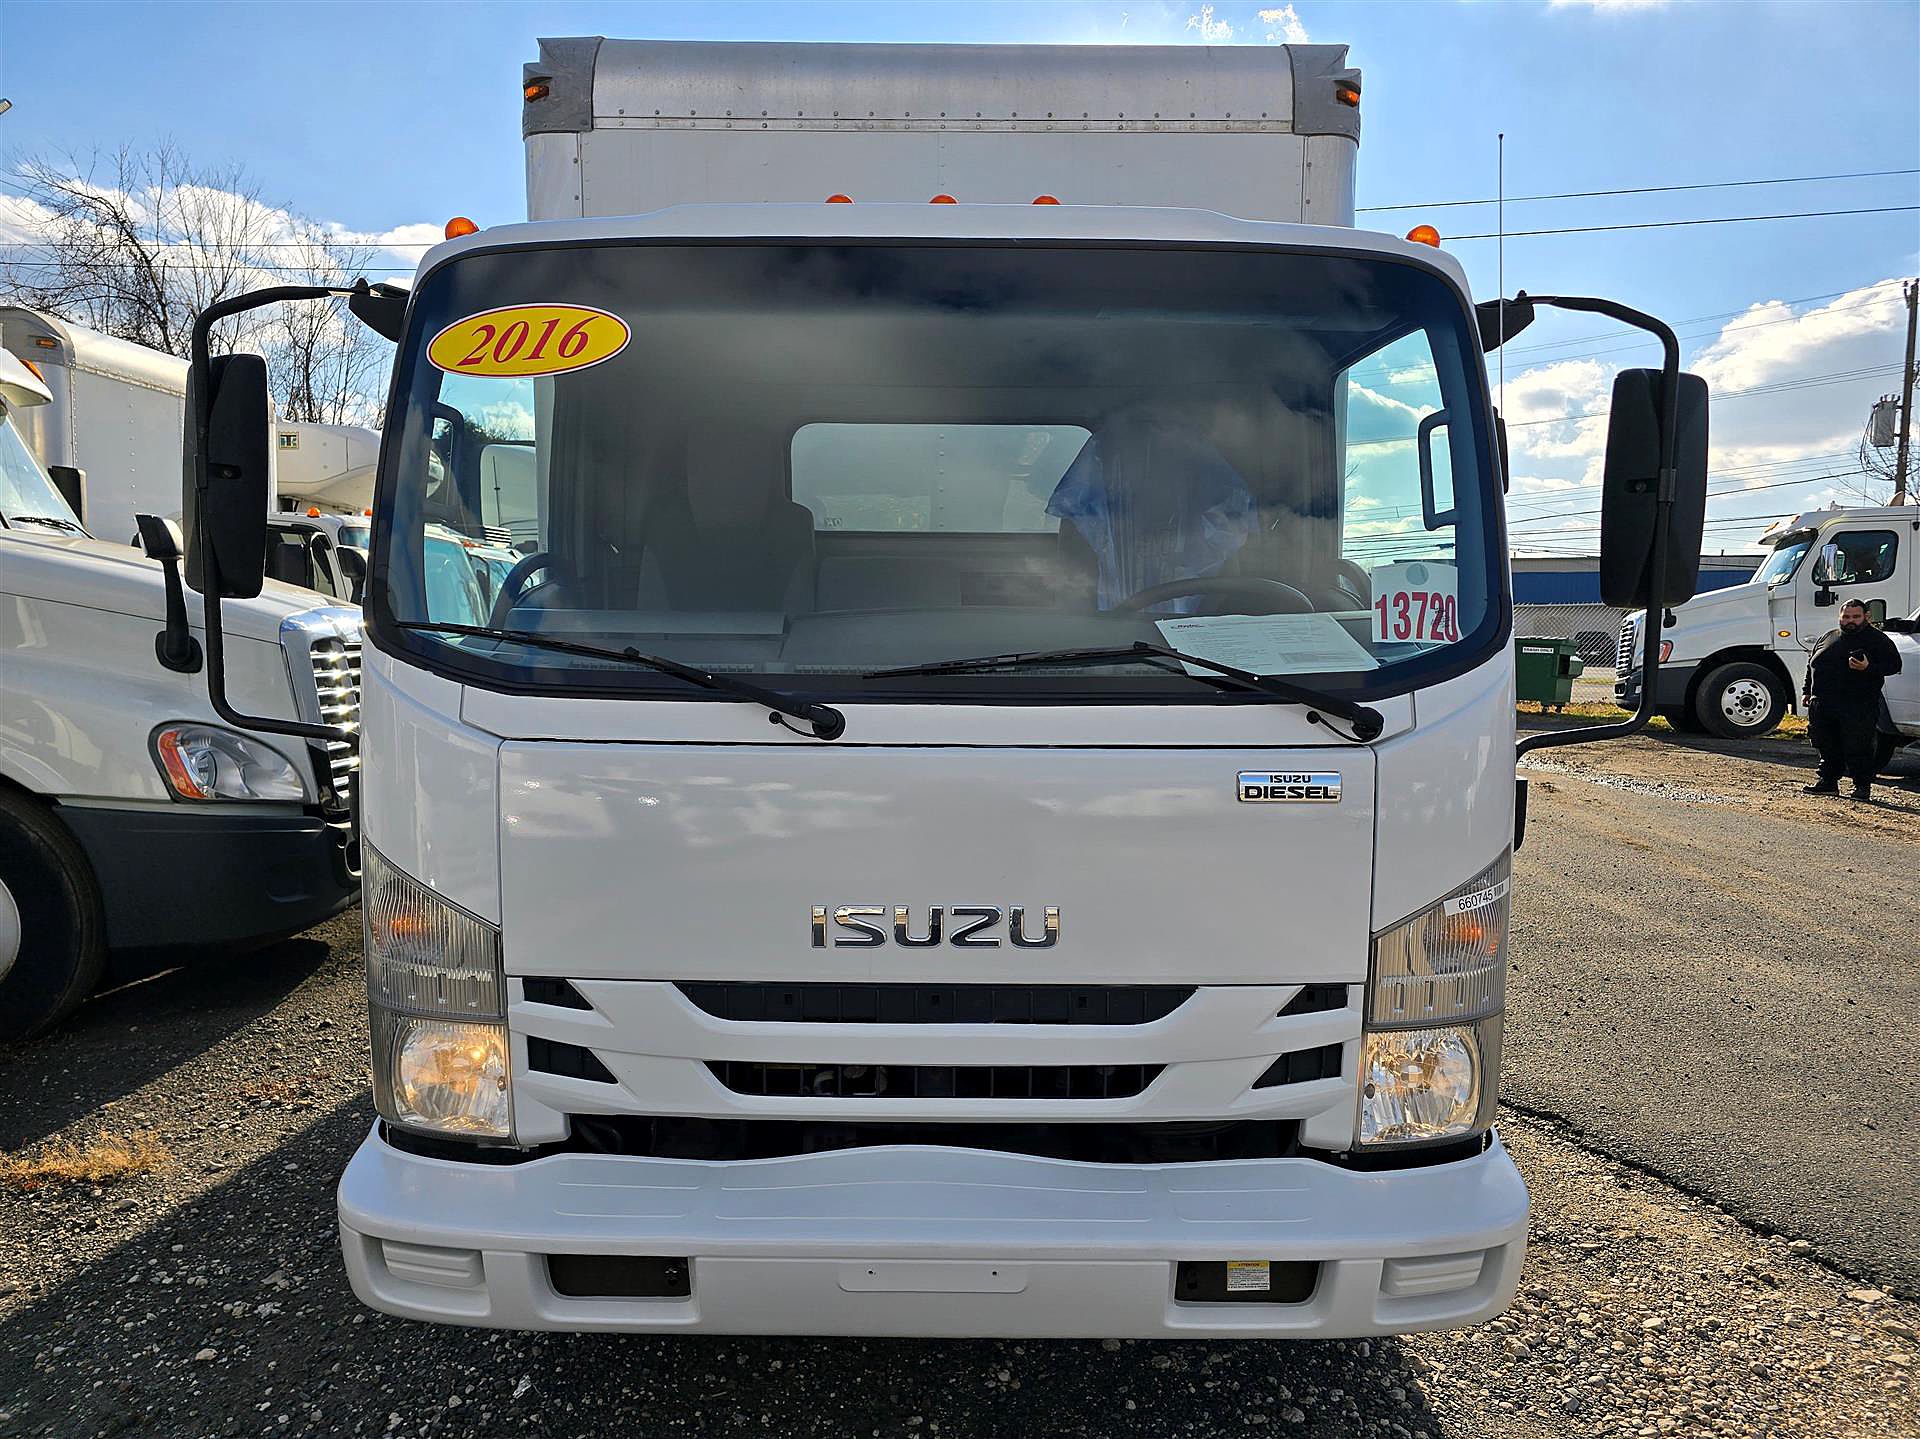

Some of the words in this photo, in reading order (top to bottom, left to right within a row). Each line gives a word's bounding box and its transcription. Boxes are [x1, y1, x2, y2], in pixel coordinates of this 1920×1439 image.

[456, 316, 599, 366] 2016
[1375, 591, 1459, 642] 13720
[1244, 786, 1338, 799] DIESEL
[1269, 775, 1311, 783] ISUZU
[1458, 889, 1494, 911] 660745
[811, 905, 1060, 948] ISUZU
